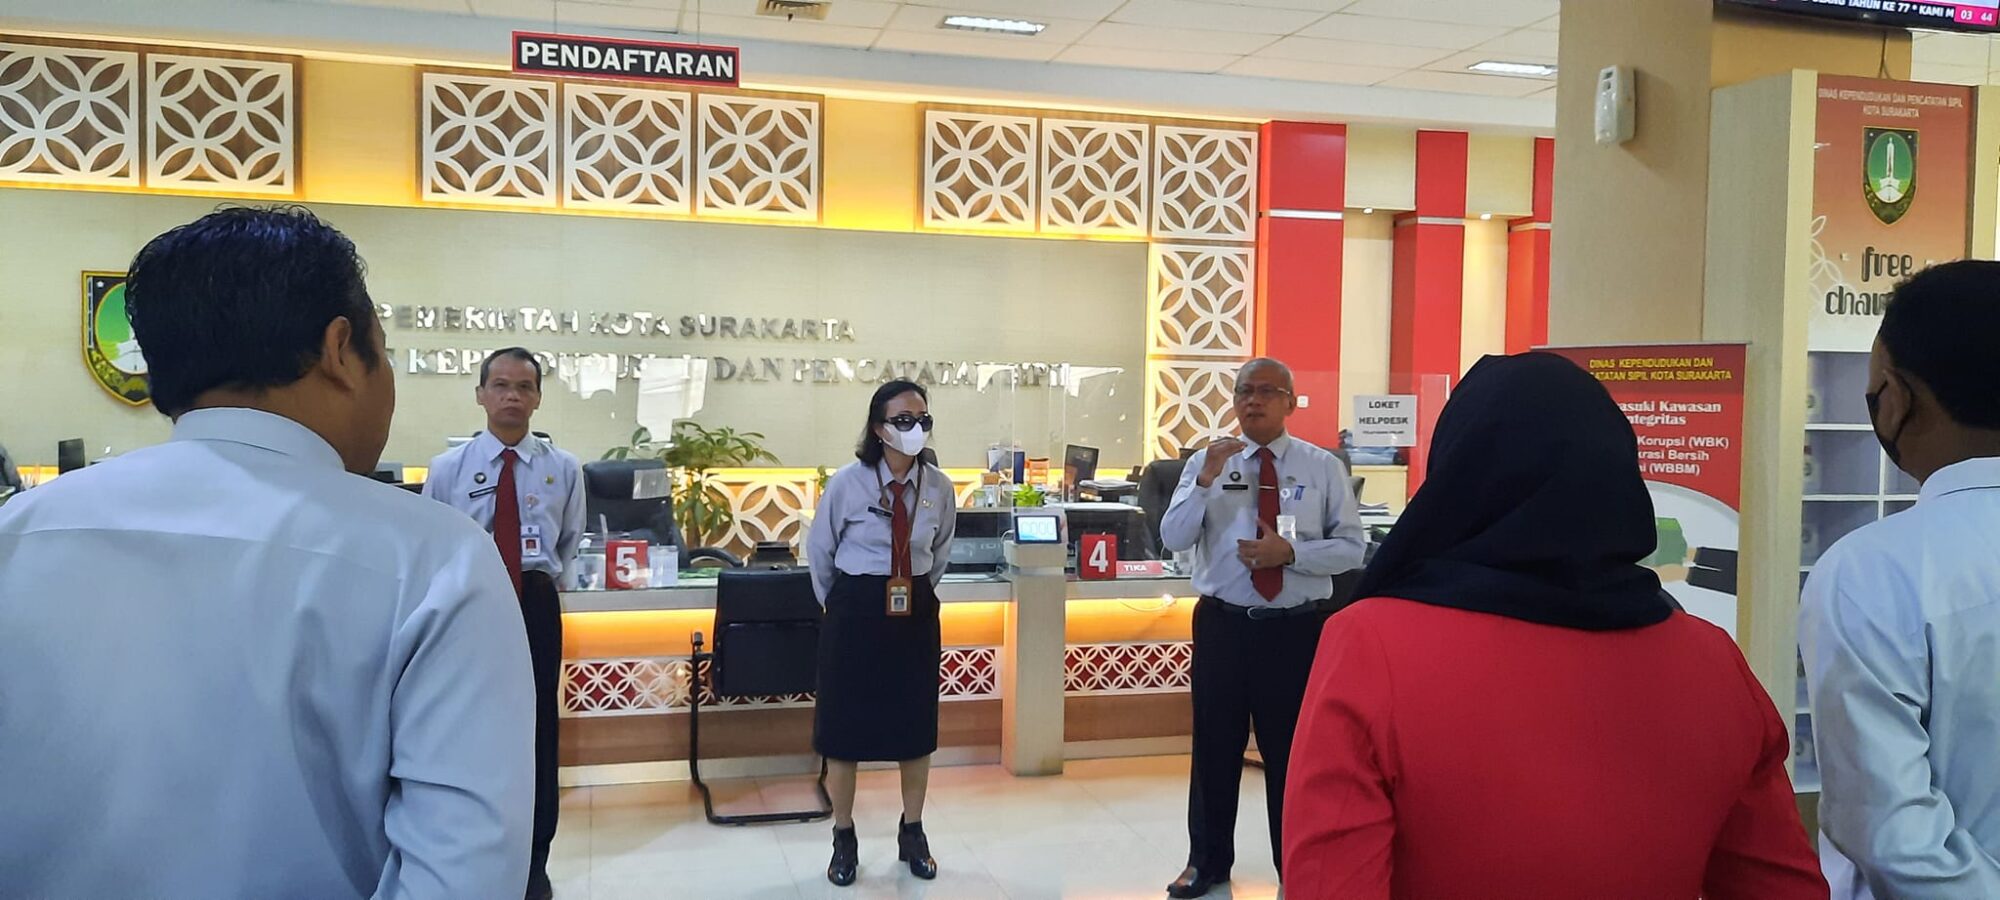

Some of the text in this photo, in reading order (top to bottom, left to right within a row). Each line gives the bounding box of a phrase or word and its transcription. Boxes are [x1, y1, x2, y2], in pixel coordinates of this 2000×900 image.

[1882, 3, 1895, 12] KE
[1898, 4, 1909, 13] 77
[1919, 7, 1944, 17] KAMI
[1960, 9, 1992, 22] 03 44
[520, 41, 734, 78] PENDAFTARAN
[1861, 246, 1913, 282] free
[375, 302, 855, 342] PEMERINTAH KOTA SURAKARTA
[714, 356, 784, 382] DAN
[1589, 357, 1713, 368] DINAS KEPENDUDUKAN DAN
[1627, 371, 1648, 381] SIPIL
[1650, 371, 1675, 380] KOTA
[1676, 370, 1732, 381] SURAKARTA
[1368, 401, 1400, 409] LOKET
[1617, 401, 1721, 413] asuki Kawasan
[1637, 436, 1729, 449] Korupsi (WBK)
[1668, 450, 1709, 460] Bersih
[1649, 463, 1700, 476] (WBBM)
[1088, 540, 1109, 573] 4
[615, 547, 638, 583] 5
